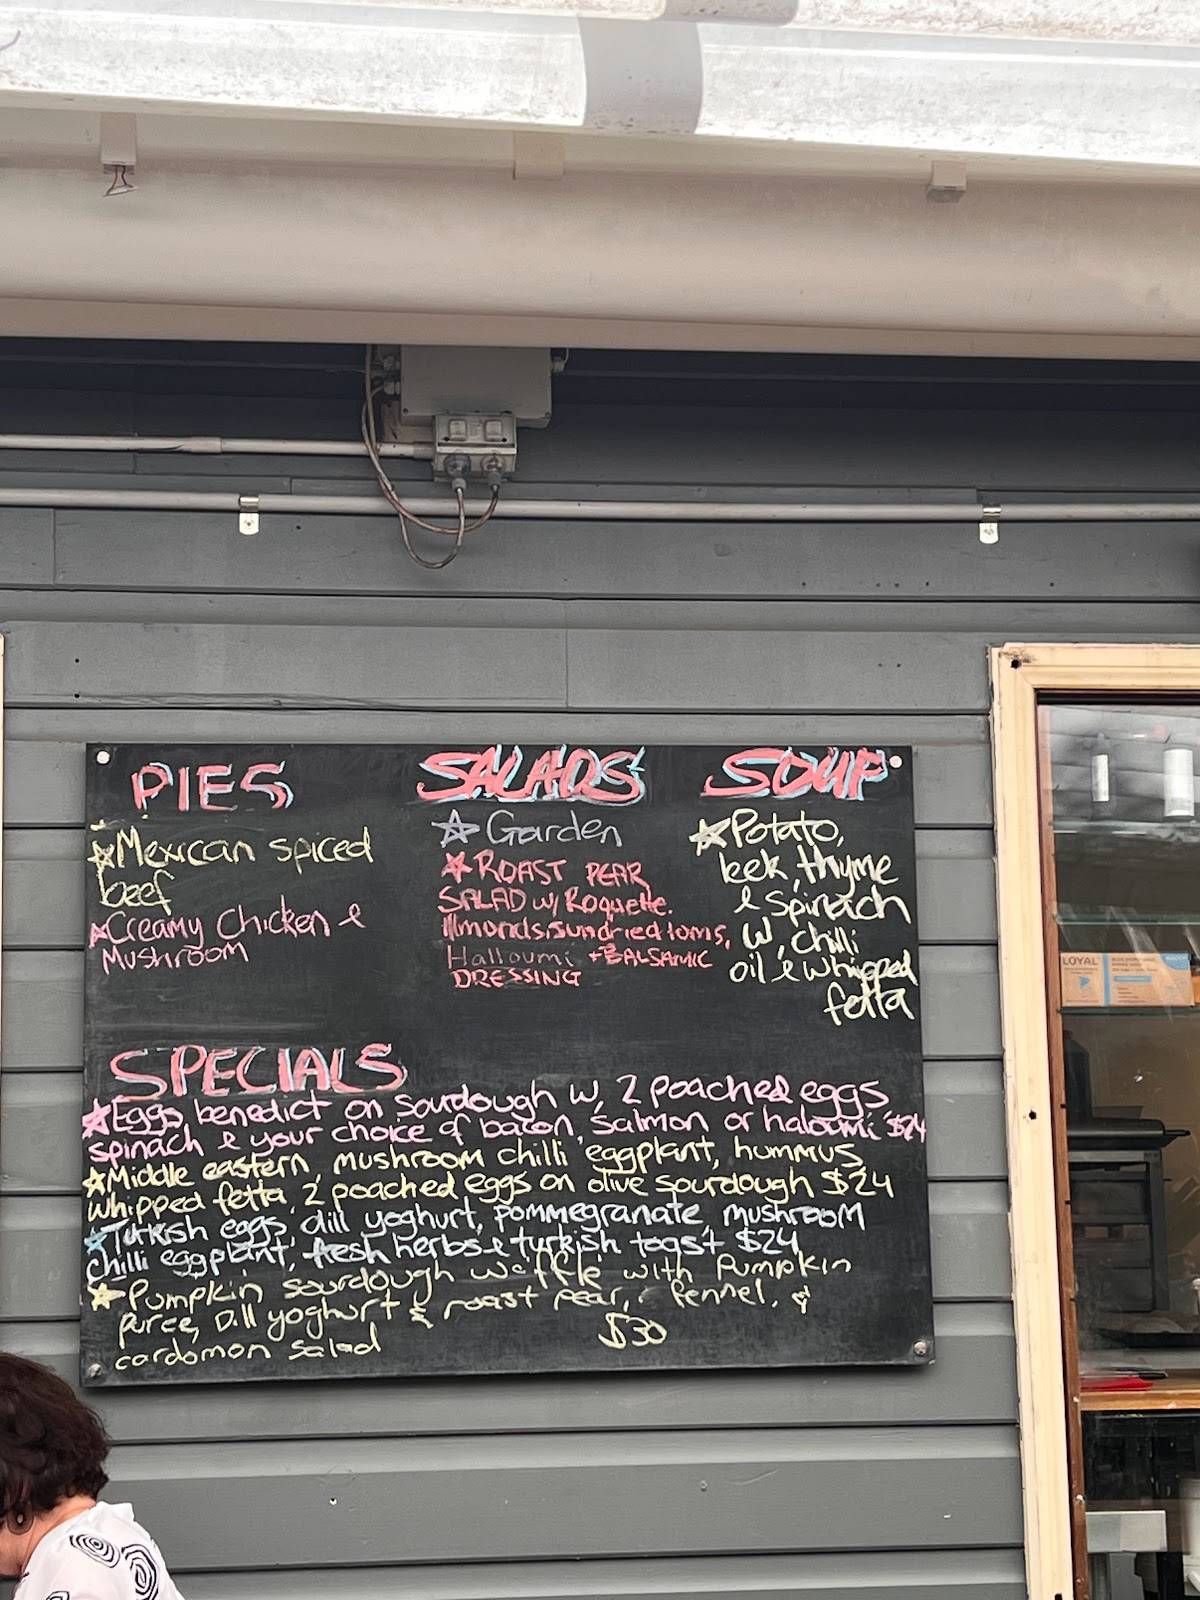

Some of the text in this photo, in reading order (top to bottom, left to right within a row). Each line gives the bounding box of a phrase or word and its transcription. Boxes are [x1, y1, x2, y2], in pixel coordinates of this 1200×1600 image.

[131, 761, 294, 811] PIES
[416, 744, 646, 806] SALADS
[700, 746, 888, 800] SOUP
[117, 826, 373, 874] Mexican spiced
[486, 809, 622, 847] Garden
[731, 808, 844, 848] Potato,
[99, 868, 175, 915] beef
[473, 849, 650, 893] ROAST PEAR
[796, 843, 899, 897] thyme
[438, 885, 527, 913] SALAD
[106, 911, 204, 948] Creamy
[447, 944, 574, 970] Halloumi
[451, 967, 582, 989] DRESSING
[728, 950, 767, 985] oil
[1062, 956, 1098, 966] LOYAL
[109, 1043, 408, 1102] SPECIALS
[111, 1099, 184, 1135] Eggs
[194, 1089, 332, 1127] benedict
[344, 1099, 384, 1120] on
[394, 1078, 557, 1122] sourdough
[616, 1074, 642, 1104] 2
[650, 1074, 793, 1109] poached
[88, 1123, 204, 1169] spinach
[250, 1126, 323, 1156] your
[331, 1117, 433, 1145] choice
[439, 1113, 471, 1146] of
[724, 1112, 753, 1132] or
[108, 1161, 195, 1192] Middle
[497, 1138, 568, 1167] chilli
[734, 1135, 864, 1168] hummus
[302, 1183, 326, 1206] 2
[332, 1171, 459, 1213] poached
[465, 1171, 532, 1204] eggs
[540, 1173, 575, 1193] on
[588, 1171, 648, 1197] olive
[655, 1167, 814, 1204] sourdough
[821, 1167, 894, 1198] $24
[300, 1209, 350, 1234] dill
[393, 1233, 481, 1260] herbs
[735, 1227, 801, 1255] $24
[129, 1278, 264, 1314] Pumpkin
[282, 1260, 455, 1306] sourdough
[624, 1252, 693, 1283] with
[444, 1285, 539, 1320] roast
[288, 1321, 381, 1361] salad
[599, 1311, 668, 1349] $30
